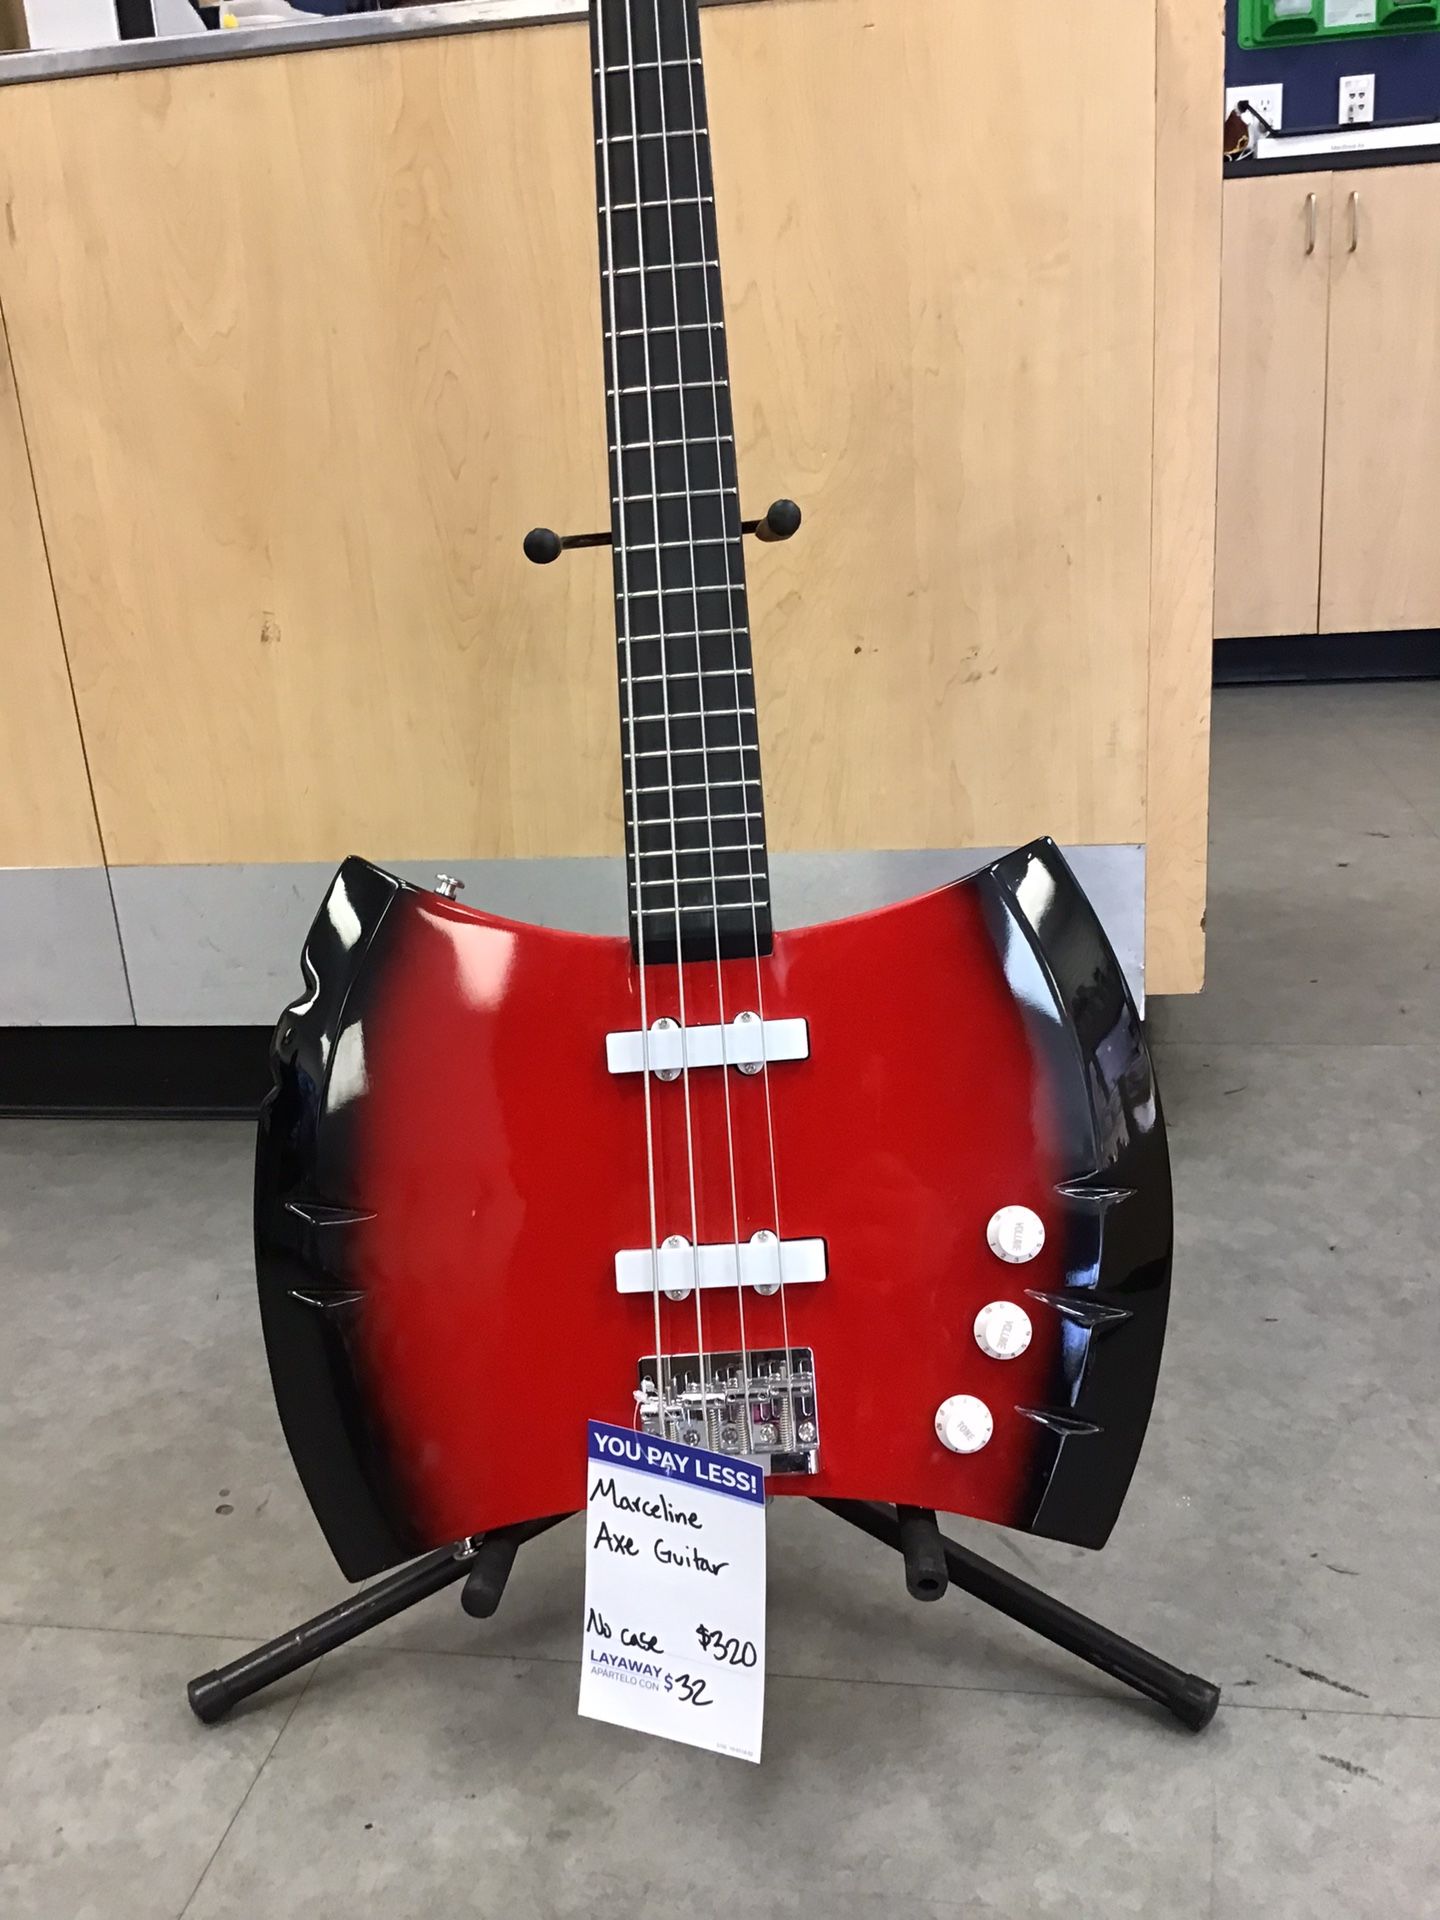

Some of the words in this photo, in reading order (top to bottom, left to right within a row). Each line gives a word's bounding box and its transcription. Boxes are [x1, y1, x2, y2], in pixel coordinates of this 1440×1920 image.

[956, 1420, 976, 1442] TONE
[593, 1432, 641, 1461] YOU
[647, 1446, 690, 1474] PAY
[695, 1459, 758, 1495] LESS!
[589, 1478, 703, 1530] Marceline
[593, 1521, 640, 1556] Axe
[653, 1538, 730, 1576] Guitar
[586, 1607, 612, 1639] No
[620, 1628, 665, 1655] case
[695, 1623, 758, 1668] $320
[590, 1649, 663, 1679] LAYAWAY
[638, 1677, 660, 1692] CON
